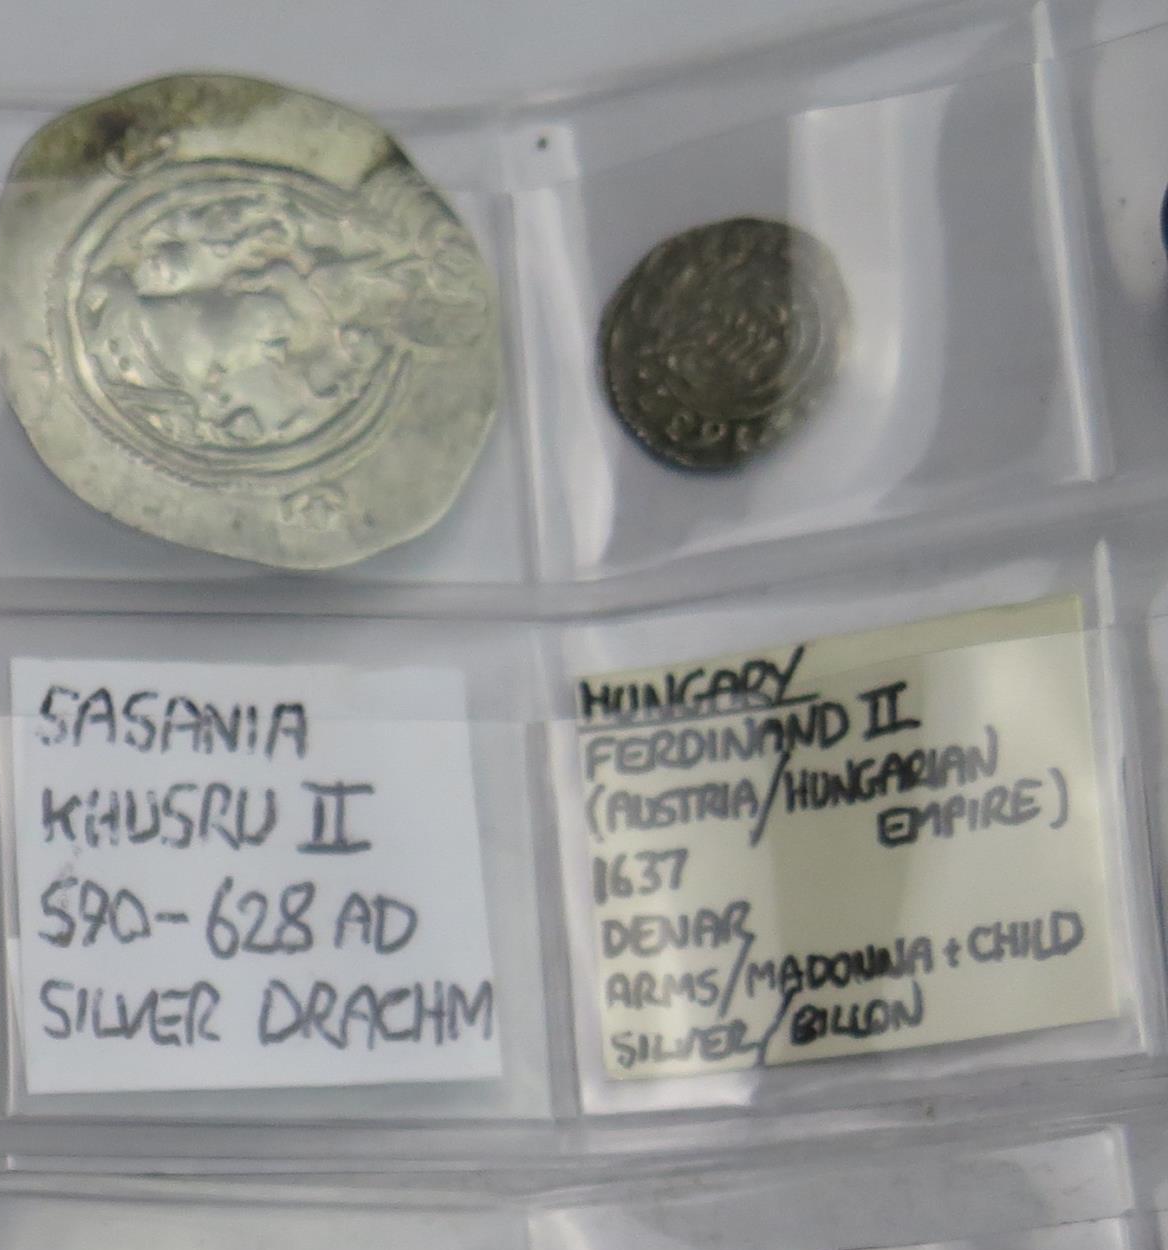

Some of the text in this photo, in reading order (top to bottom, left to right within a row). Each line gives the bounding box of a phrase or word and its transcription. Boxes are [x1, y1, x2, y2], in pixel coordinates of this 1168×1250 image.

[580, 645, 804, 722] HUNGARY
[37, 685, 308, 758] SASANIA
[586, 681, 921, 781] FERDINAND II
[41, 781, 374, 853] KHUSRU II
[878, 767, 1069, 847] EMPIRE)
[593, 848, 689, 905] 1637
[334, 892, 418, 955] AD
[602, 900, 751, 958] DENAR
[967, 910, 1085, 962] CHILD
[39, 979, 494, 1049] SILVER DRACHM
